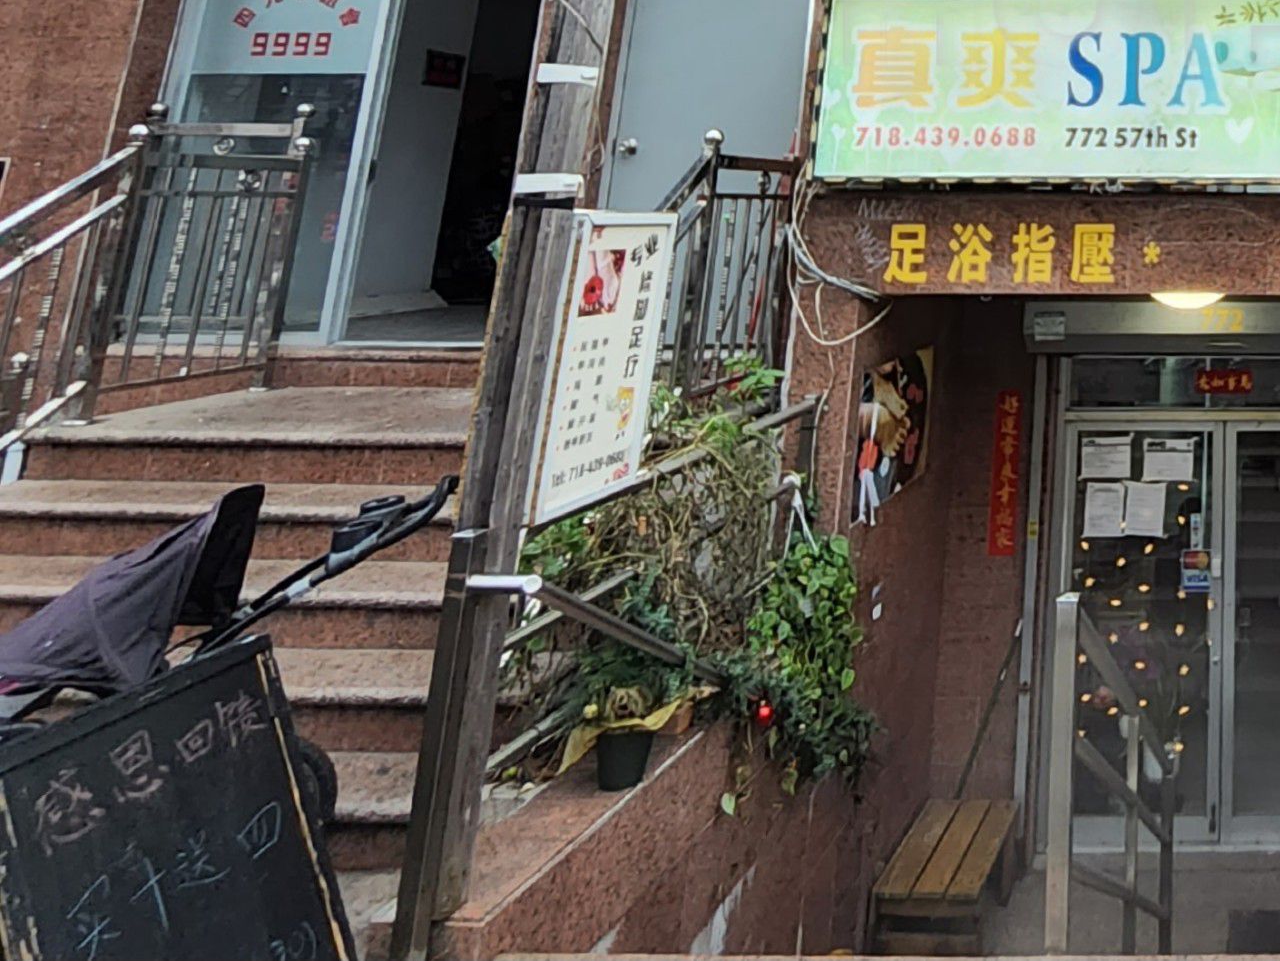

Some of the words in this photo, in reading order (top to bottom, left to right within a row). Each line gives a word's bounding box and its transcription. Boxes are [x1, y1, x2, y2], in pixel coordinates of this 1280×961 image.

[250, 32, 332, 57] 9999
[1067, 31, 1226, 107] SPA
[856, 127, 1036, 147] 718.439.0688
[1065, 127, 1107, 147] 772
[1114, 125, 1168, 147] 57th
[1175, 127, 1199, 147] St
[882, 222, 1116, 284] 足浴指壓
